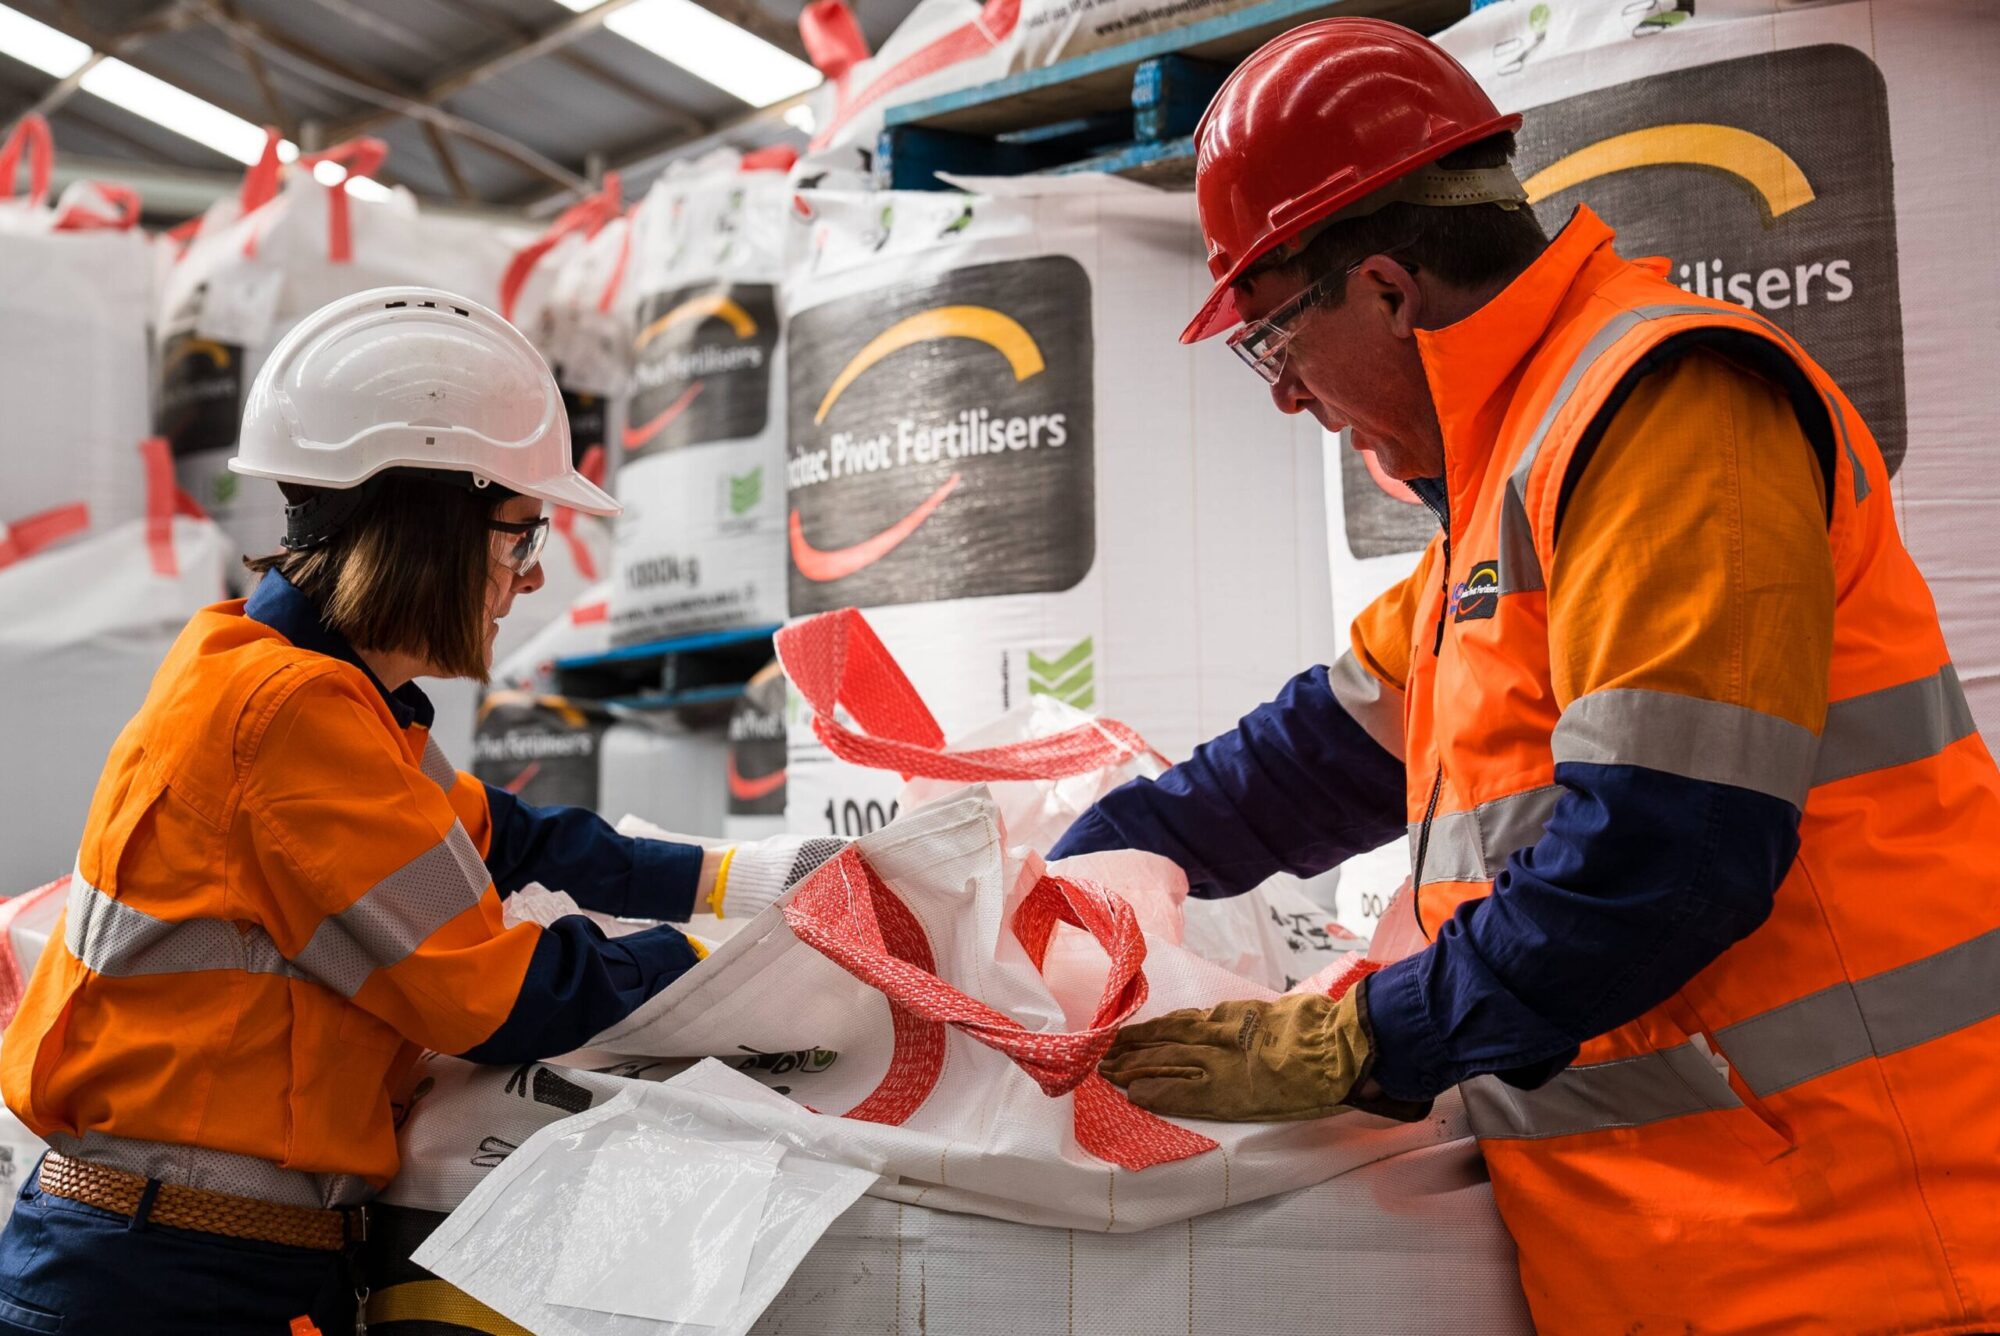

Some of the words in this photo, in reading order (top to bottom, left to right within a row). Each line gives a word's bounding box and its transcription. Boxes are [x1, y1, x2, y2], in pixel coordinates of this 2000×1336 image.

[1679, 258, 1853, 310] ilisers
[831, 432, 892, 479] Pivot
[897, 407, 1067, 466] Fertilisers
